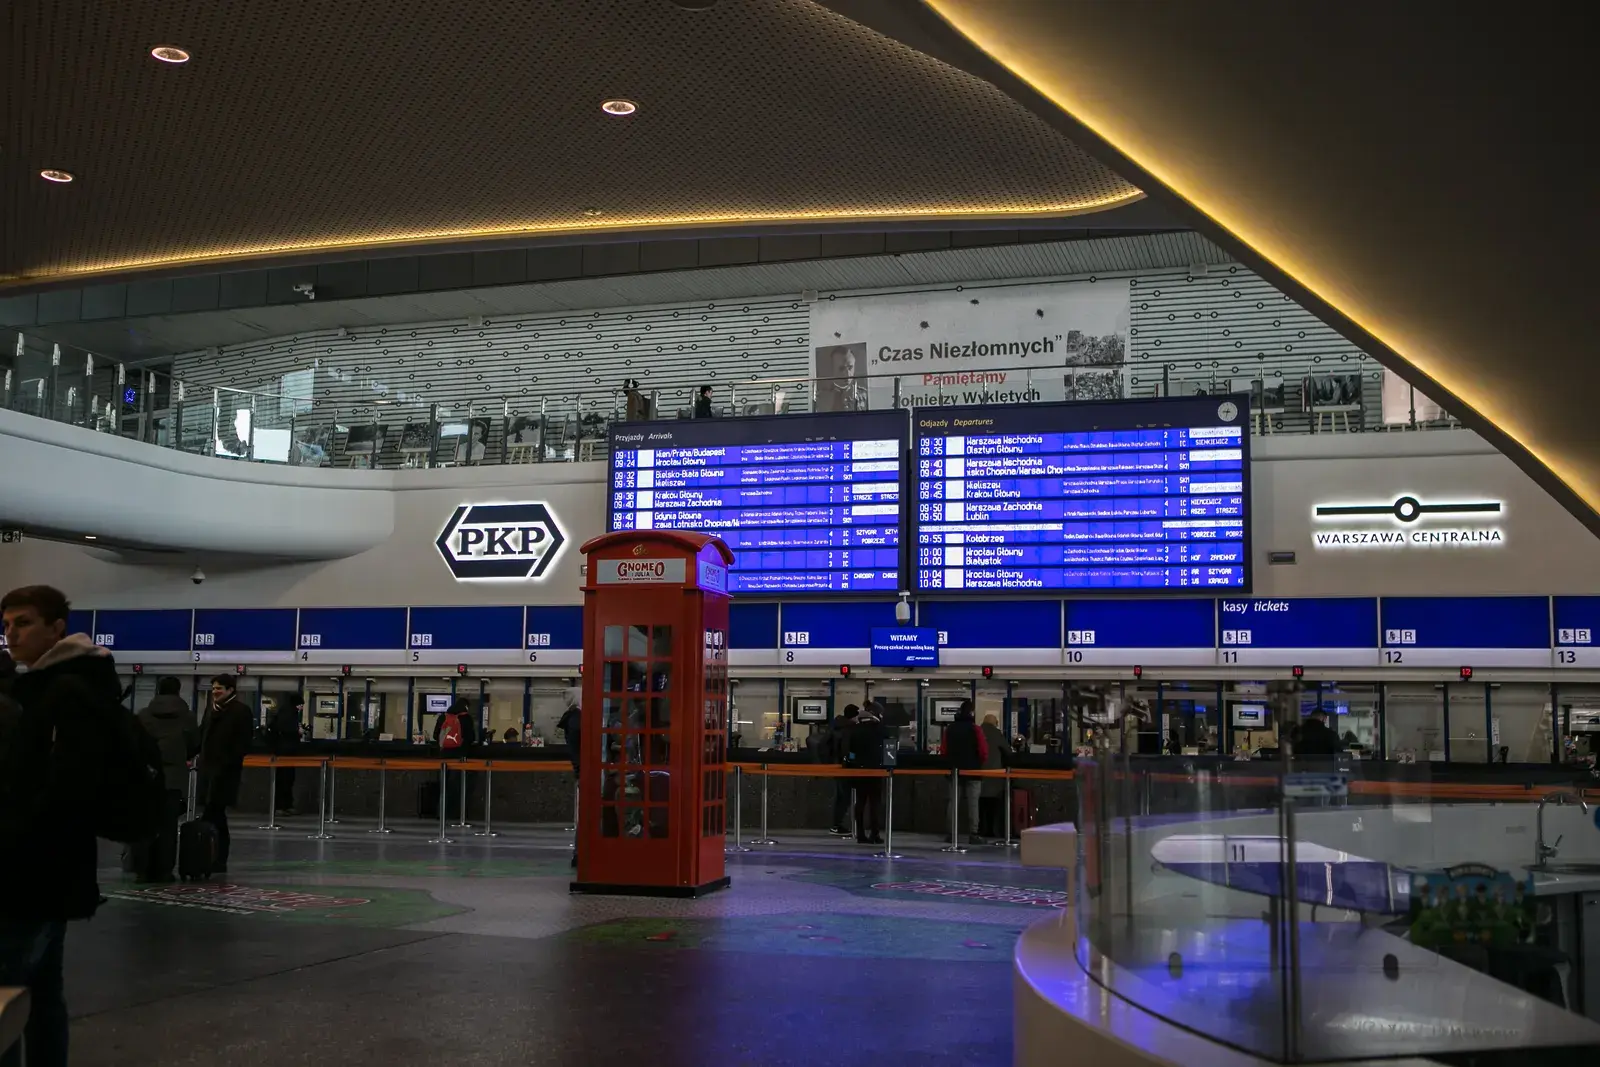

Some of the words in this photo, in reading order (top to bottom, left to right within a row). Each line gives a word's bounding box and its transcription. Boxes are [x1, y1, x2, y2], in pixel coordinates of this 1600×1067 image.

[871, 346, 923, 366] „Czas
[930, 335, 1062, 359] Niezłomnych”
[923, 372, 1006, 387] Pamiętamy
[920, 419, 948, 429] Odjazdy
[953, 418, 994, 427] Departures
[615, 433, 644, 442] Przyjazdy
[648, 432, 673, 440] Arrivals
[920, 438, 943, 447] 09:30
[966, 437, 1002, 446] Warszawa
[1003, 435, 1043, 444] Wschodnia
[920, 446, 943, 455] 09:35
[966, 445, 995, 455] Olsztyn
[1195, 438, 1229, 446] SIENKIEWICZ
[615, 451, 635, 460] 09:11
[655, 447, 726, 458] Wien/Praha/Budapest
[615, 459, 635, 468] 09:24
[655, 458, 681, 467] Wrocław
[920, 459, 943, 469] 09:40
[966, 459, 1002, 468] Warszawa
[1003, 457, 1043, 466] Wschodnia
[614, 471, 635, 480] 09:32
[655, 469, 699, 479] Bielsko-Biała
[920, 468, 943, 478] 09:40
[986, 466, 1046, 476] Chopina/Warsaw
[614, 480, 635, 488] 09:35
[655, 479, 686, 487] Wieliszew
[920, 481, 943, 491] 09:45
[966, 481, 1001, 490] Wieliszew
[614, 492, 635, 501] 09:36
[920, 490, 943, 500] 09:45
[613, 500, 635, 509] 09:40
[654, 499, 686, 508] Warszawa
[687, 498, 723, 507] Zachodnia
[920, 504, 943, 513] 09:50
[966, 503, 1002, 512] Warszawa
[1003, 501, 1043, 511] Zachodnia
[613, 511, 634, 521] 09:40
[654, 512, 677, 521] Gdynia
[920, 512, 943, 521] 09:50
[966, 512, 990, 521] Lublin
[613, 520, 634, 530] 09:44
[673, 518, 704, 529] Lotnisko
[457, 526, 545, 556] PKP
[920, 535, 942, 544] 09:55
[966, 534, 1005, 543] Kołobrzeg
[1317, 533, 1405, 544] WARSZAWA
[1412, 531, 1501, 543] CENTRALNA
[920, 548, 942, 557] 10:00
[966, 548, 995, 557] Wrocław
[920, 557, 942, 566] 10:00
[965, 556, 1002, 566] Białystok
[617, 561, 665, 577] GNOMEO
[920, 570, 942, 579] 10:04
[966, 570, 995, 579] Wrocław
[920, 579, 942, 588] 10:05
[965, 579, 1001, 588] Warszawa
[1002, 578, 1043, 587] Wschodnia
[1223, 601, 1248, 614] kasy
[1253, 601, 1289, 612] tickets
[195, 653, 200, 662] 3
[302, 652, 309, 661] 4
[412, 652, 419, 662] 5
[530, 652, 536, 662] 6
[786, 652, 794, 662] 8
[1067, 651, 1082, 663] 10
[1223, 652, 1237, 663] 11
[1385, 651, 1402, 663] 12
[1558, 651, 1576, 663] 13
